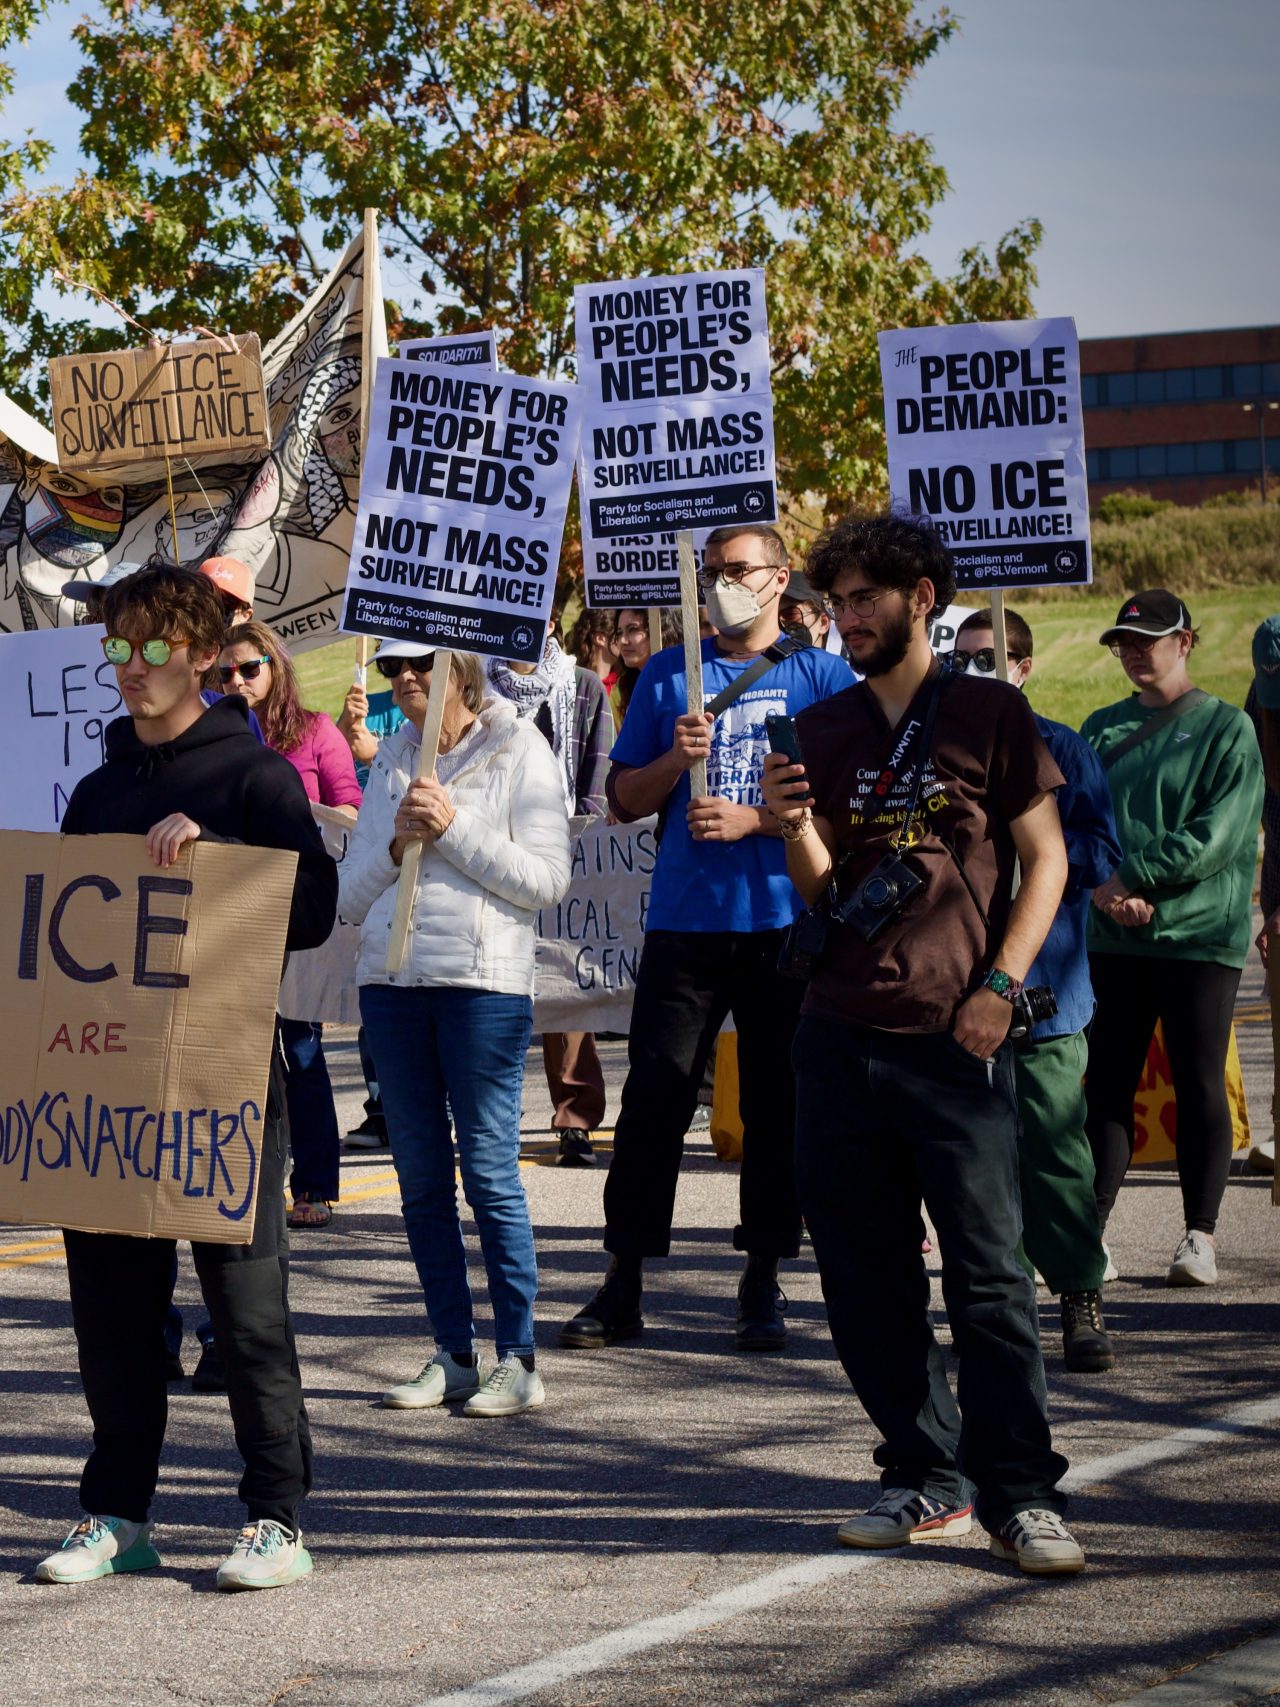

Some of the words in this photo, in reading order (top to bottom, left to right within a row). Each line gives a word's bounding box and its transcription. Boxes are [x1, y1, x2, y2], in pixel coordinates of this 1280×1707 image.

[588, 285, 689, 324] MONEY
[695, 280, 752, 310] FOR
[418, 346, 483, 363] SOLIDARITY!
[894, 345, 919, 369] THE
[920, 346, 1067, 394] PEOPLE
[71, 362, 123, 403] NO
[161, 351, 241, 396] ICE
[600, 349, 751, 403] NEEDS,
[389, 371, 504, 415] MONEY
[508, 389, 568, 427] FOR
[896, 388, 1068, 435] DEMAND:
[60, 390, 264, 457] SURVEILLANCE
[592, 422, 657, 461] NOT
[666, 411, 765, 453] MASS
[385, 446, 547, 519] NEEDS,
[593, 450, 766, 488] SURVEILLANCE!
[909, 464, 976, 515] NO
[991, 459, 1068, 511] ICE
[599, 504, 626, 517] Party
[627, 502, 642, 513] for
[643, 498, 693, 511] Socialism
[694, 494, 714, 506] and
[600, 514, 651, 528] Liberation
[665, 504, 738, 522] @PSLVermont
[365, 513, 438, 557] NOT
[446, 527, 550, 577] MASS
[931, 514, 1072, 543] RVEILLANCE!
[954, 554, 1002, 566] Socialism
[1004, 552, 1023, 563] and
[974, 563, 1048, 579] @PSLVermont
[358, 555, 545, 609] SURVEILLANCE!
[594, 584, 613, 594] Party
[615, 584, 624, 592] for
[625, 583, 663, 592] Socialism
[664, 583, 677, 591] and
[595, 591, 631, 600] Liberation
[355, 610, 410, 630] Liberation
[425, 623, 505, 645] @PSLVermont
[357, 599, 386, 615] Party
[388, 603, 404, 616] for
[405, 605, 458, 625] Socialism
[459, 615, 482, 628] and
[888, 720, 921, 768] LUMIX
[858, 783, 873, 794] the
[921, 773, 936, 783] the
[928, 793, 950, 812] CIA
[18, 873, 193, 989] ICE
[48, 1021, 128, 1055] ARE
